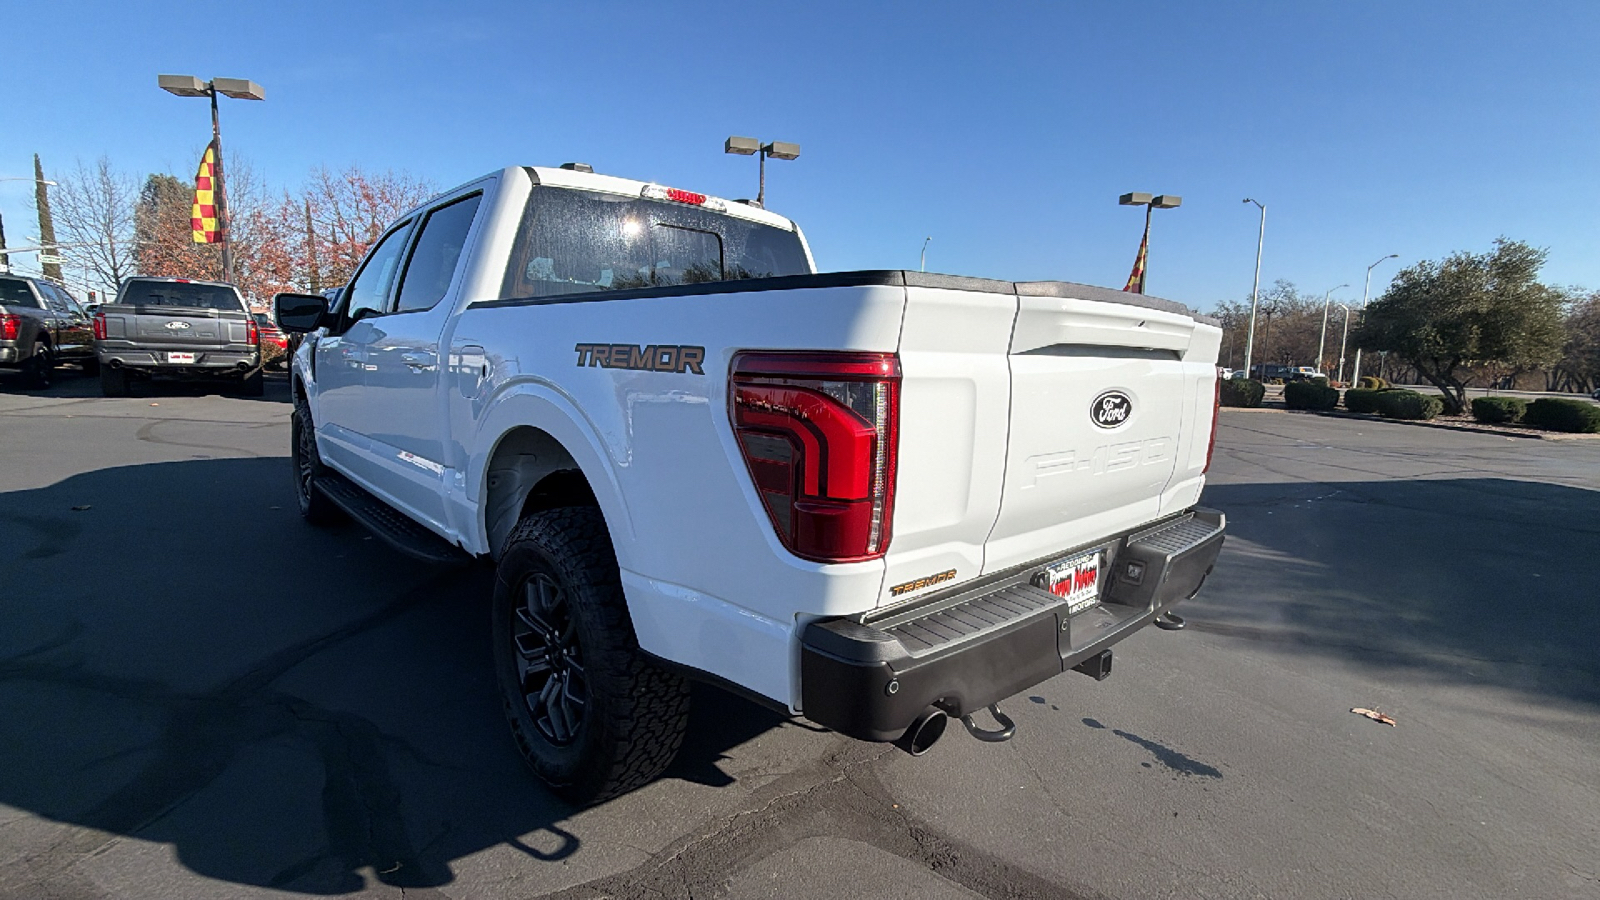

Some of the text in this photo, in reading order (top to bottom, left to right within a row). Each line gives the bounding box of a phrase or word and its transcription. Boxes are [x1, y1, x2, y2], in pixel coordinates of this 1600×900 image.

[575, 343, 705, 375] TREMOR
[1099, 397, 1128, 423] Ford
[1021, 436, 1171, 490] F-150
[1060, 554, 1090, 570] REDDING
[889, 568, 957, 597] TREMOR
